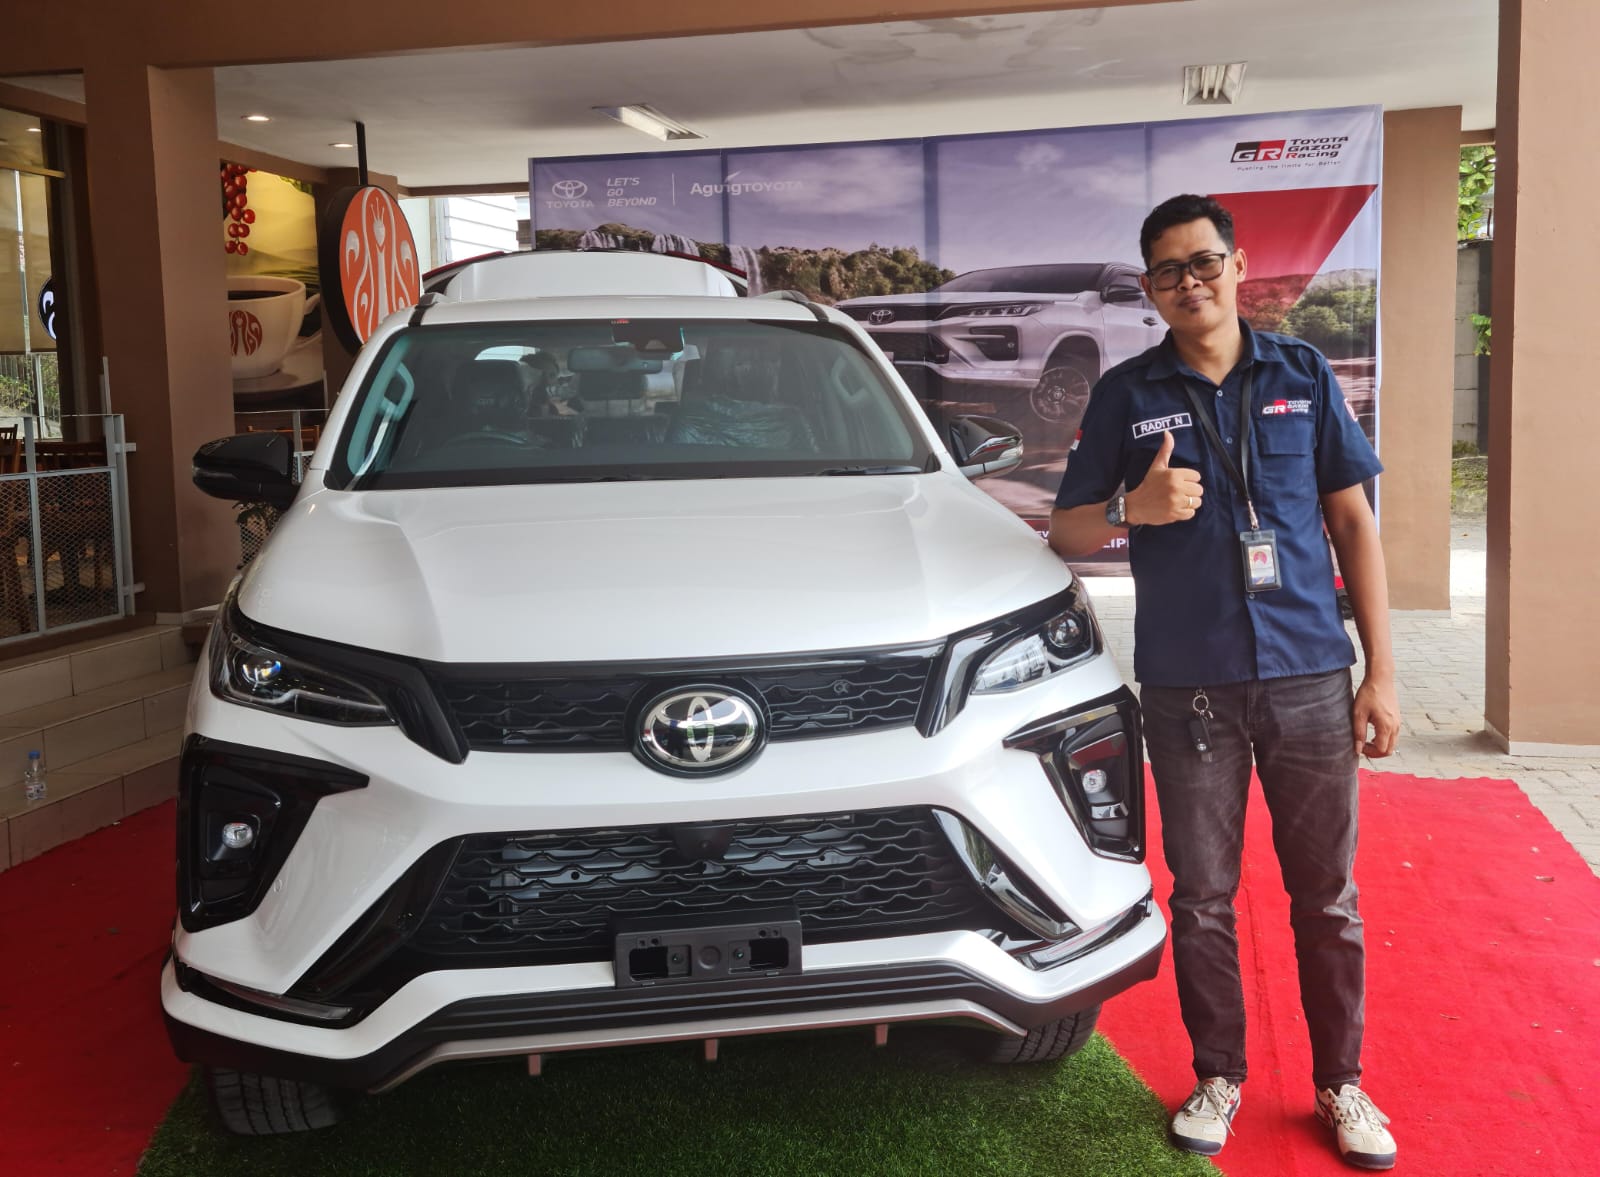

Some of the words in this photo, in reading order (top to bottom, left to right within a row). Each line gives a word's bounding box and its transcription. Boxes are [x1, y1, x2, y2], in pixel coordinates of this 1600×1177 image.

[1290, 136, 1349, 146] TOYOTA
[1287, 144, 1342, 153] GAZOO
[1232, 148, 1281, 161] GR
[1285, 151, 1340, 160] Racing
[607, 177, 640, 187] LET'S
[607, 187, 624, 197] GO
[546, 199, 595, 209] TOYOTA
[607, 197, 657, 207] BEYOND
[1262, 405, 1286, 414] GR
[1140, 418, 1172, 434] RADIT
[1174, 416, 1184, 425] N
